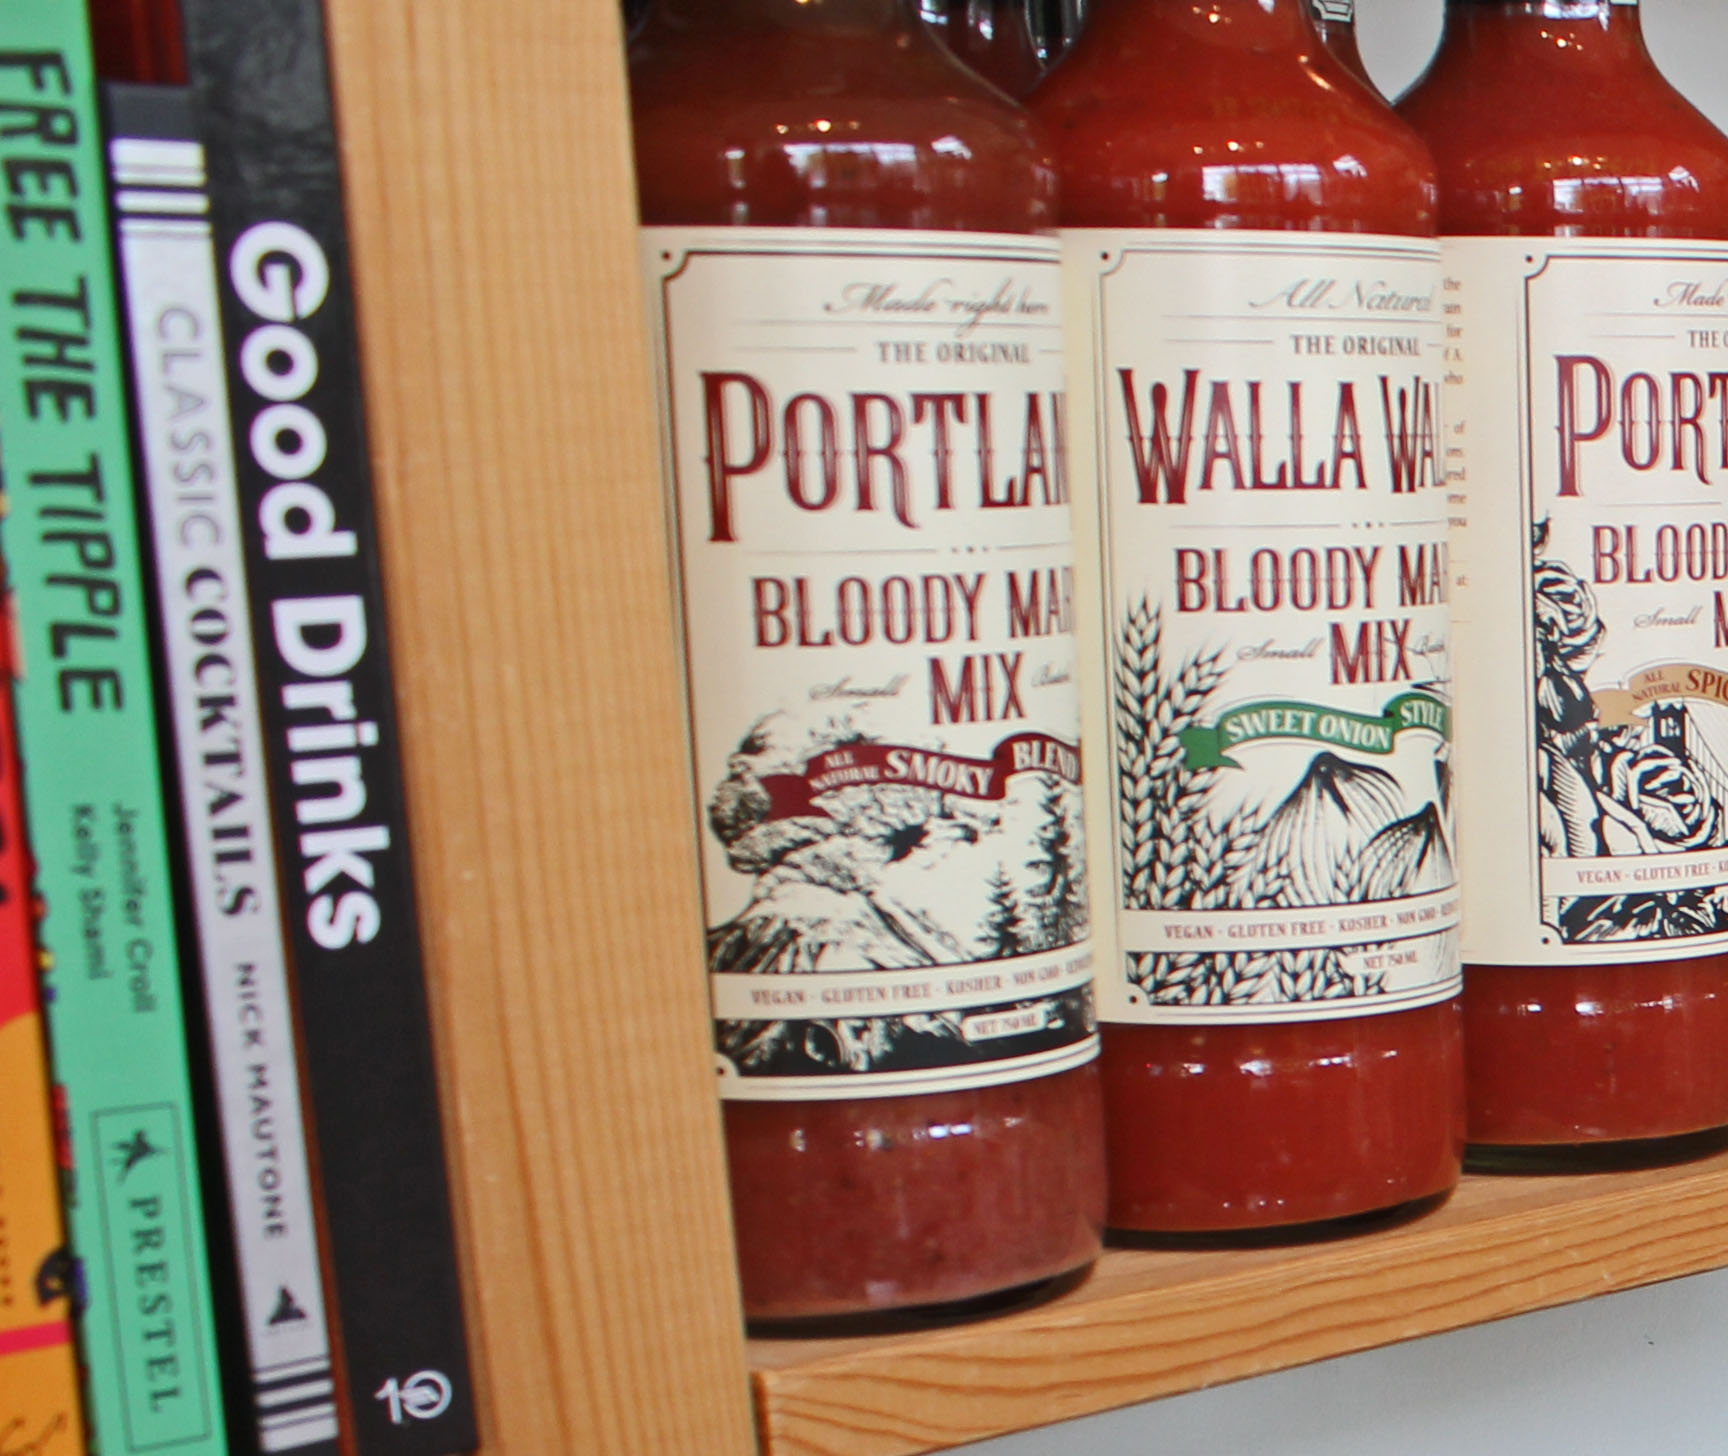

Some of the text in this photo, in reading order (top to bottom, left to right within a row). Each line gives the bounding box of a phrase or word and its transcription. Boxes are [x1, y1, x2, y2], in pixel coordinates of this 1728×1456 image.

[0, 50, 124, 712] FREE THE TIPPLE
[1116, 368, 1367, 504] WALLA
[229, 220, 391, 952] Good Drinks
[752, 573, 988, 648] BLOODY
[1174, 546, 1382, 613] BLOODY
[1329, 618, 1412, 685] MIX
[1224, 702, 1444, 750] SWEET ONION STYLE
[155, 305, 284, 1240] CLASSIC COCKTAILS NICK MAUTONE
[885, 740, 1081, 796] SMOKY BLEND
[1164, 915, 1388, 940] VEGAN GLUTEN FREE KOSHER
[128, 1196, 180, 1415] PRESTEL
